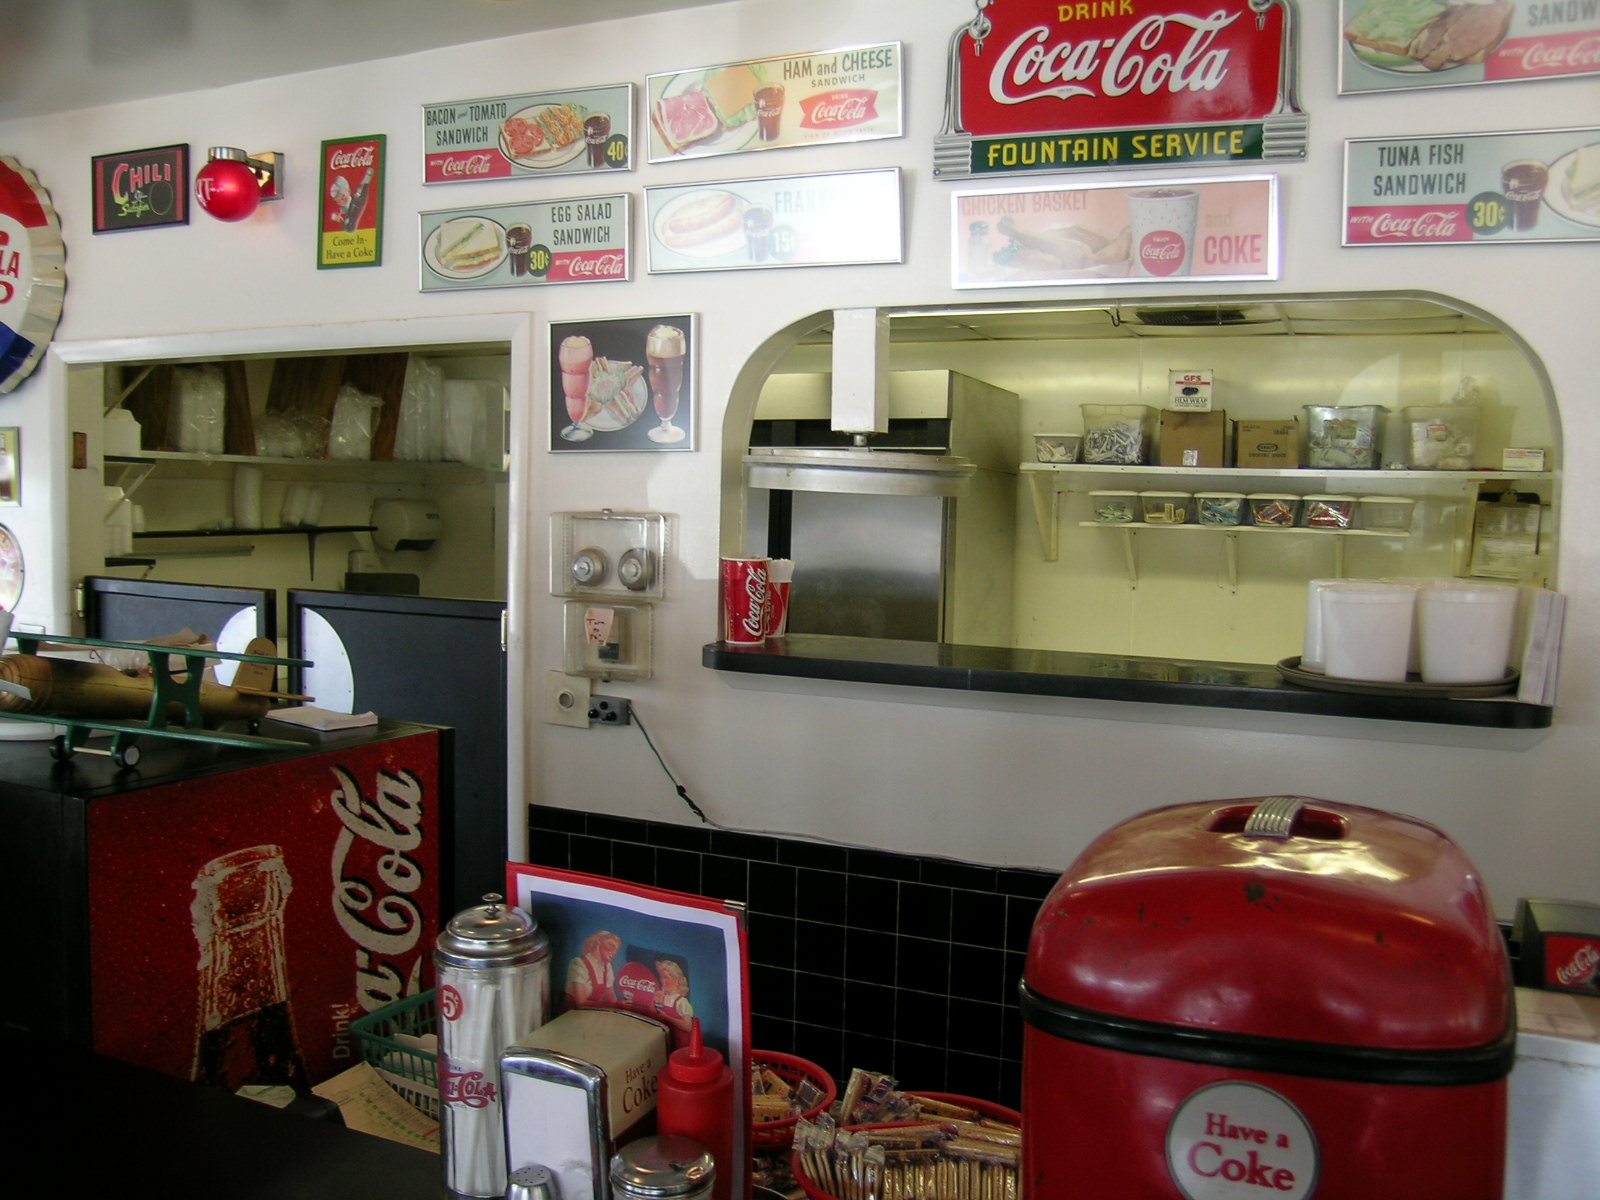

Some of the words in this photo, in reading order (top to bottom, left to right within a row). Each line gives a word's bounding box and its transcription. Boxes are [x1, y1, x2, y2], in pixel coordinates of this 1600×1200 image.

[1058, 0, 1135, 22] DRINK
[783, 59, 812, 80] HAM
[816, 56, 837, 76] and
[842, 49, 893, 73] CHEESE
[989, 10, 1243, 104] Coca-Cola
[811, 74, 865, 88] SANDWICH
[426, 108, 456, 126] BACON
[469, 103, 507, 122] TOMATO
[811, 97, 868, 124] Coca-Cola
[436, 126, 488, 146] SANDWICH
[330, 147, 375, 170] Coca-Cola
[988, 137, 1119, 167] FOUNTAIN
[1132, 130, 1244, 158] SERVICE
[1378, 145, 1420, 167] TUNA
[1429, 143, 1464, 165] FISH
[442, 154, 494, 176] Coca-Cola
[112, 163, 171, 205] CHILI
[1373, 173, 1466, 196] SANDWICH
[551, 205, 571, 223] EGG
[577, 202, 612, 221] SALAD
[961, 190, 1026, 217] CHICKEN
[1032, 189, 1089, 213] BASKET
[1473, 201, 1507, 227] 30¢
[1204, 207, 1233, 229] and
[1371, 211, 1459, 239] Coca-Cola
[332, 236, 355, 248] Come
[553, 226, 610, 246] SANDWICH
[326, 249, 345, 260] Have
[353, 246, 374, 258] Coke
[530, 251, 549, 270] 30¢
[1142, 243, 1181, 260] Coca-Cola
[1203, 234, 1263, 265] COKE
[569, 254, 625, 277] Coca-Cola
[742, 563, 767, 636] Coca-Cola
[619, 975, 656, 993] Coca-Cola
[331, 1002, 351, 1059] Drink!
[625, 1063, 646, 1084] Have
[1205, 1111, 1268, 1145] Have
[1276, 1132, 1290, 1149] a
[1187, 1142, 1296, 1192] Coke
